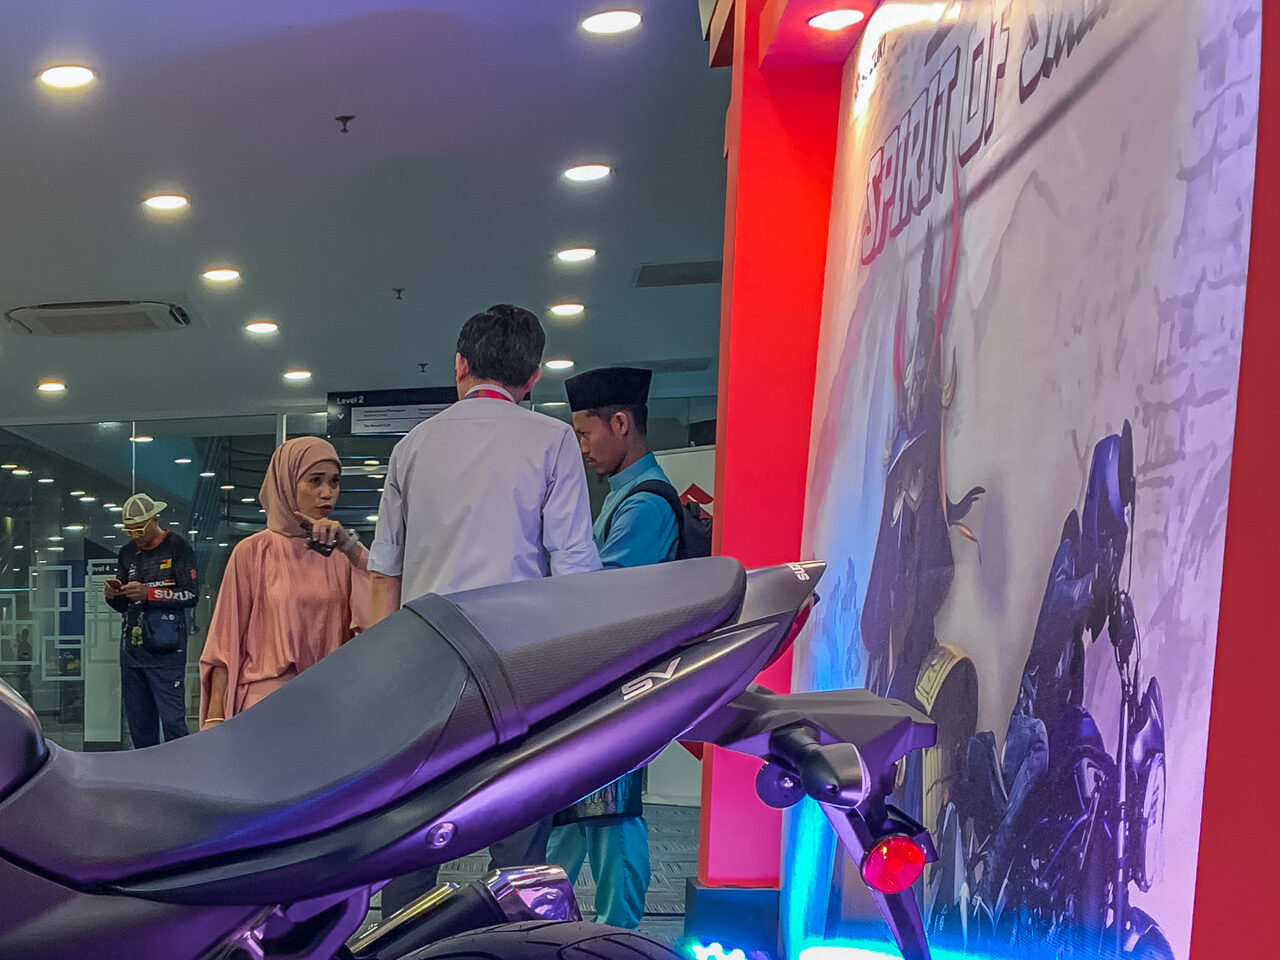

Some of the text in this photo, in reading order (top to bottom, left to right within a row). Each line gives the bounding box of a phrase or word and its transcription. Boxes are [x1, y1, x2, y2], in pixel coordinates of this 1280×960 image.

[336, 395, 365, 405] Level 2
[621, 656, 682, 701] SV
